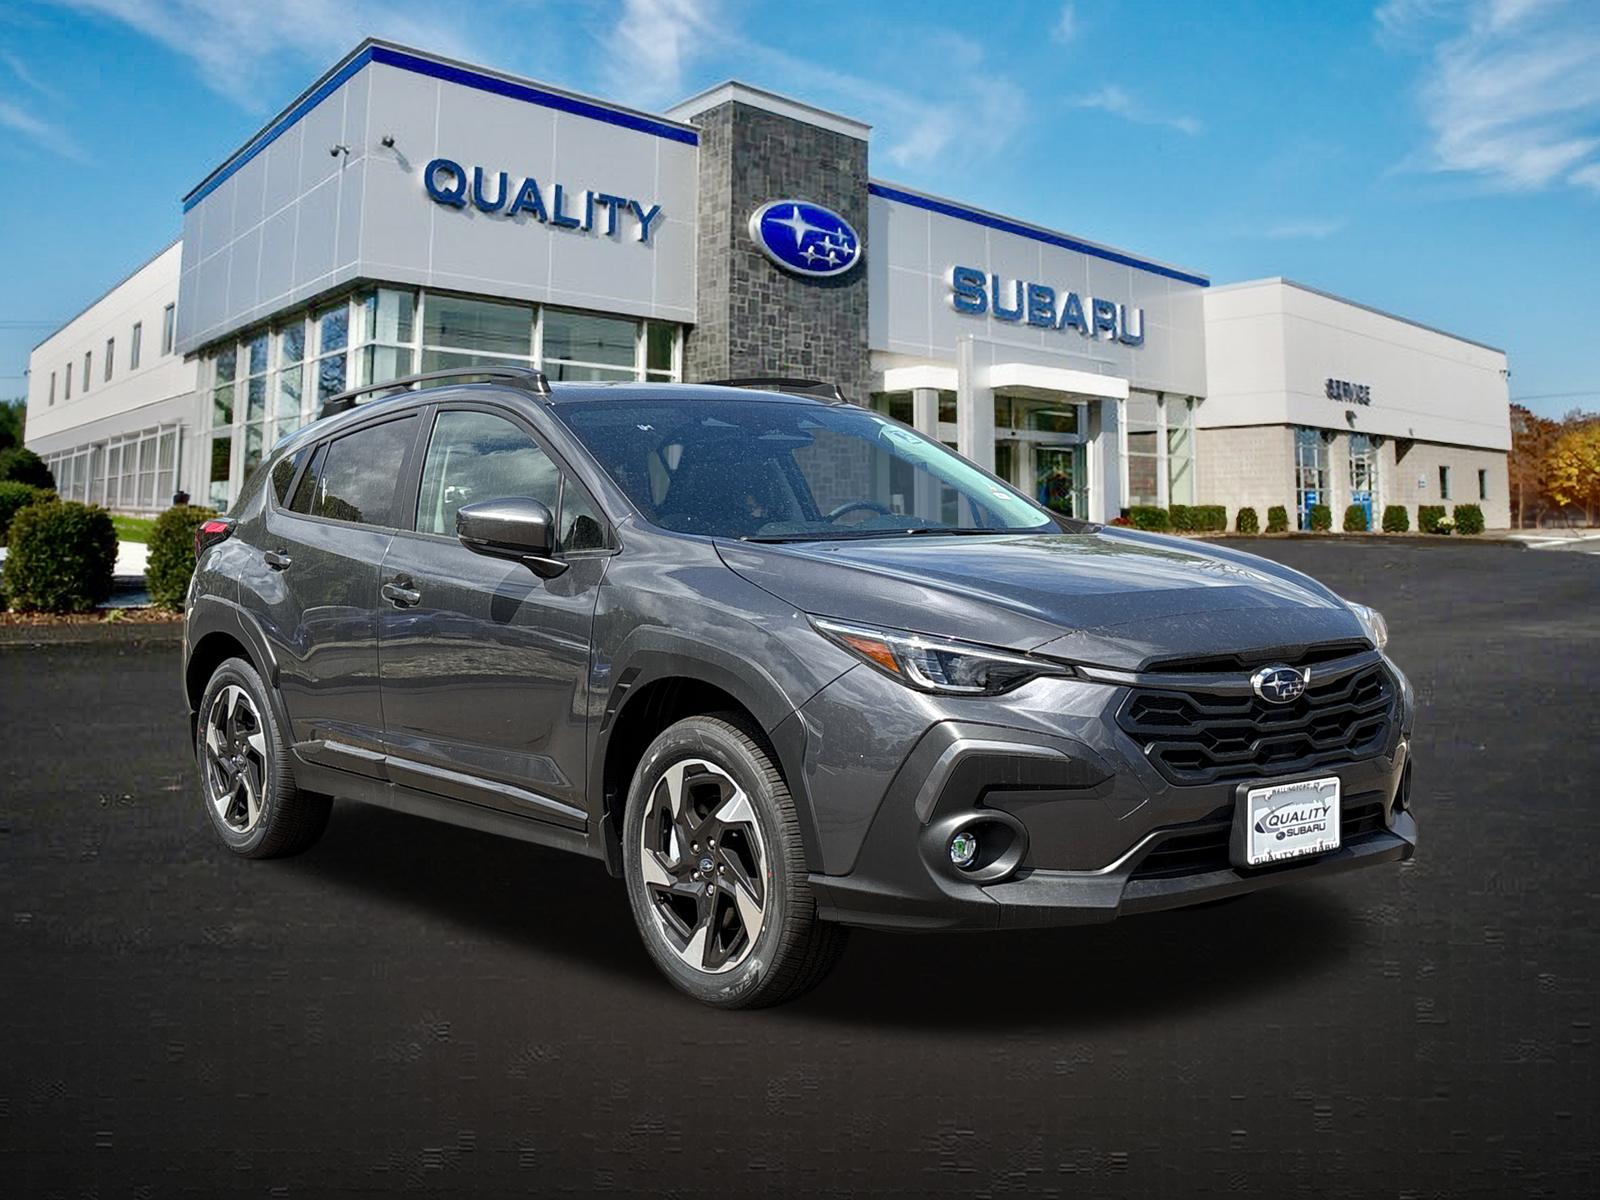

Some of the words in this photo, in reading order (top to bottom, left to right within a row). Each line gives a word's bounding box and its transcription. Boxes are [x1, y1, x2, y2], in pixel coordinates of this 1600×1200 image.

[424, 158, 662, 242] QUALITY
[950, 265, 1144, 346] SUBARU
[1268, 805, 1331, 827] QUALITY
[1286, 822, 1326, 837] SUBARU
[1253, 850, 1295, 865] QUALITY
